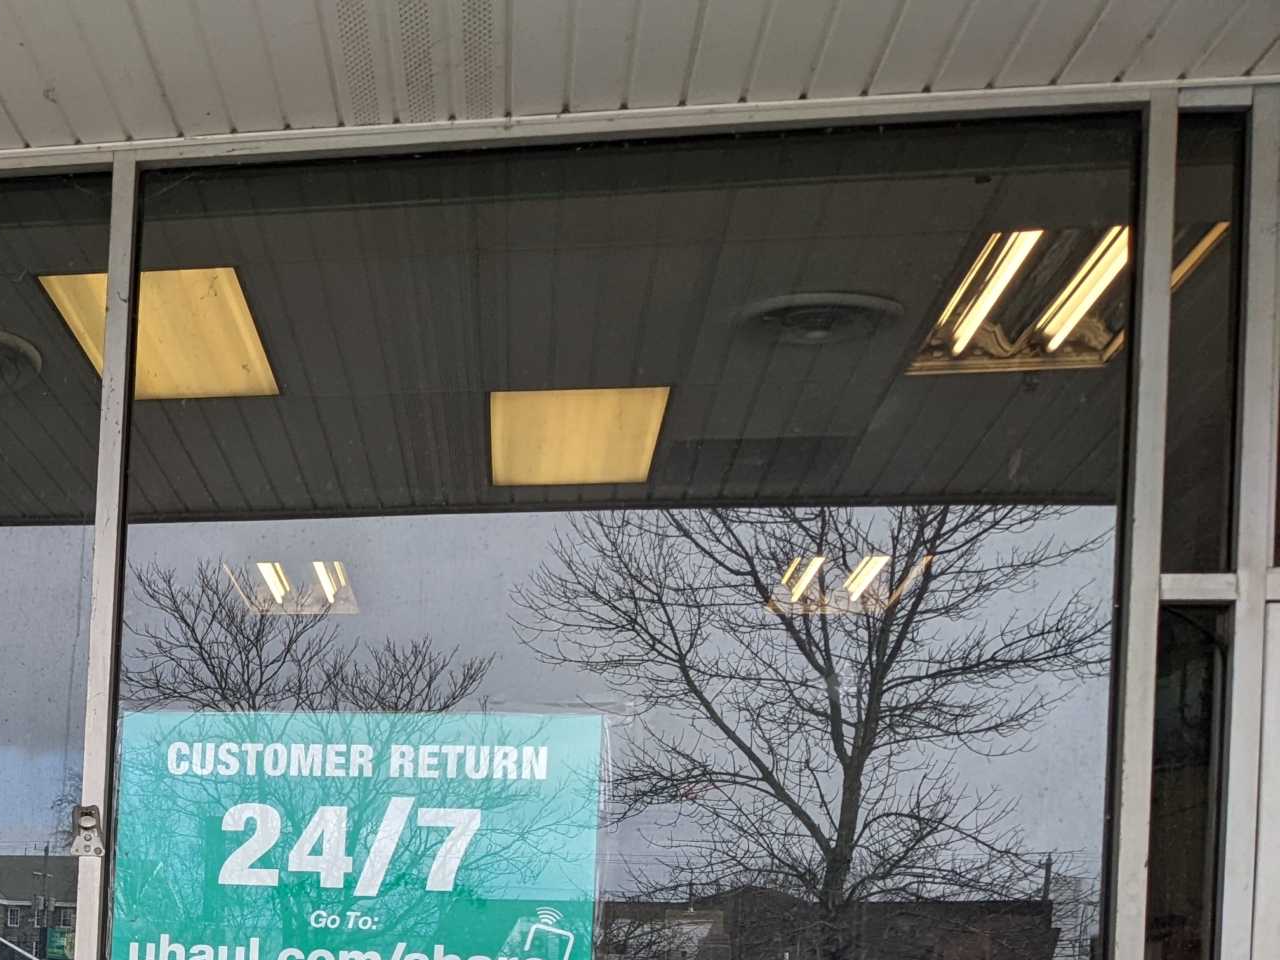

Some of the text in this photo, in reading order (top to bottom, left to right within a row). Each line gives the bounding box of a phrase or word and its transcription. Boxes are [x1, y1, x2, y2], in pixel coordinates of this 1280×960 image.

[166, 741, 549, 781] CUSTOMER RETURN
[217, 796, 482, 898] 24/7
[309, 911, 379, 931] Go To:
